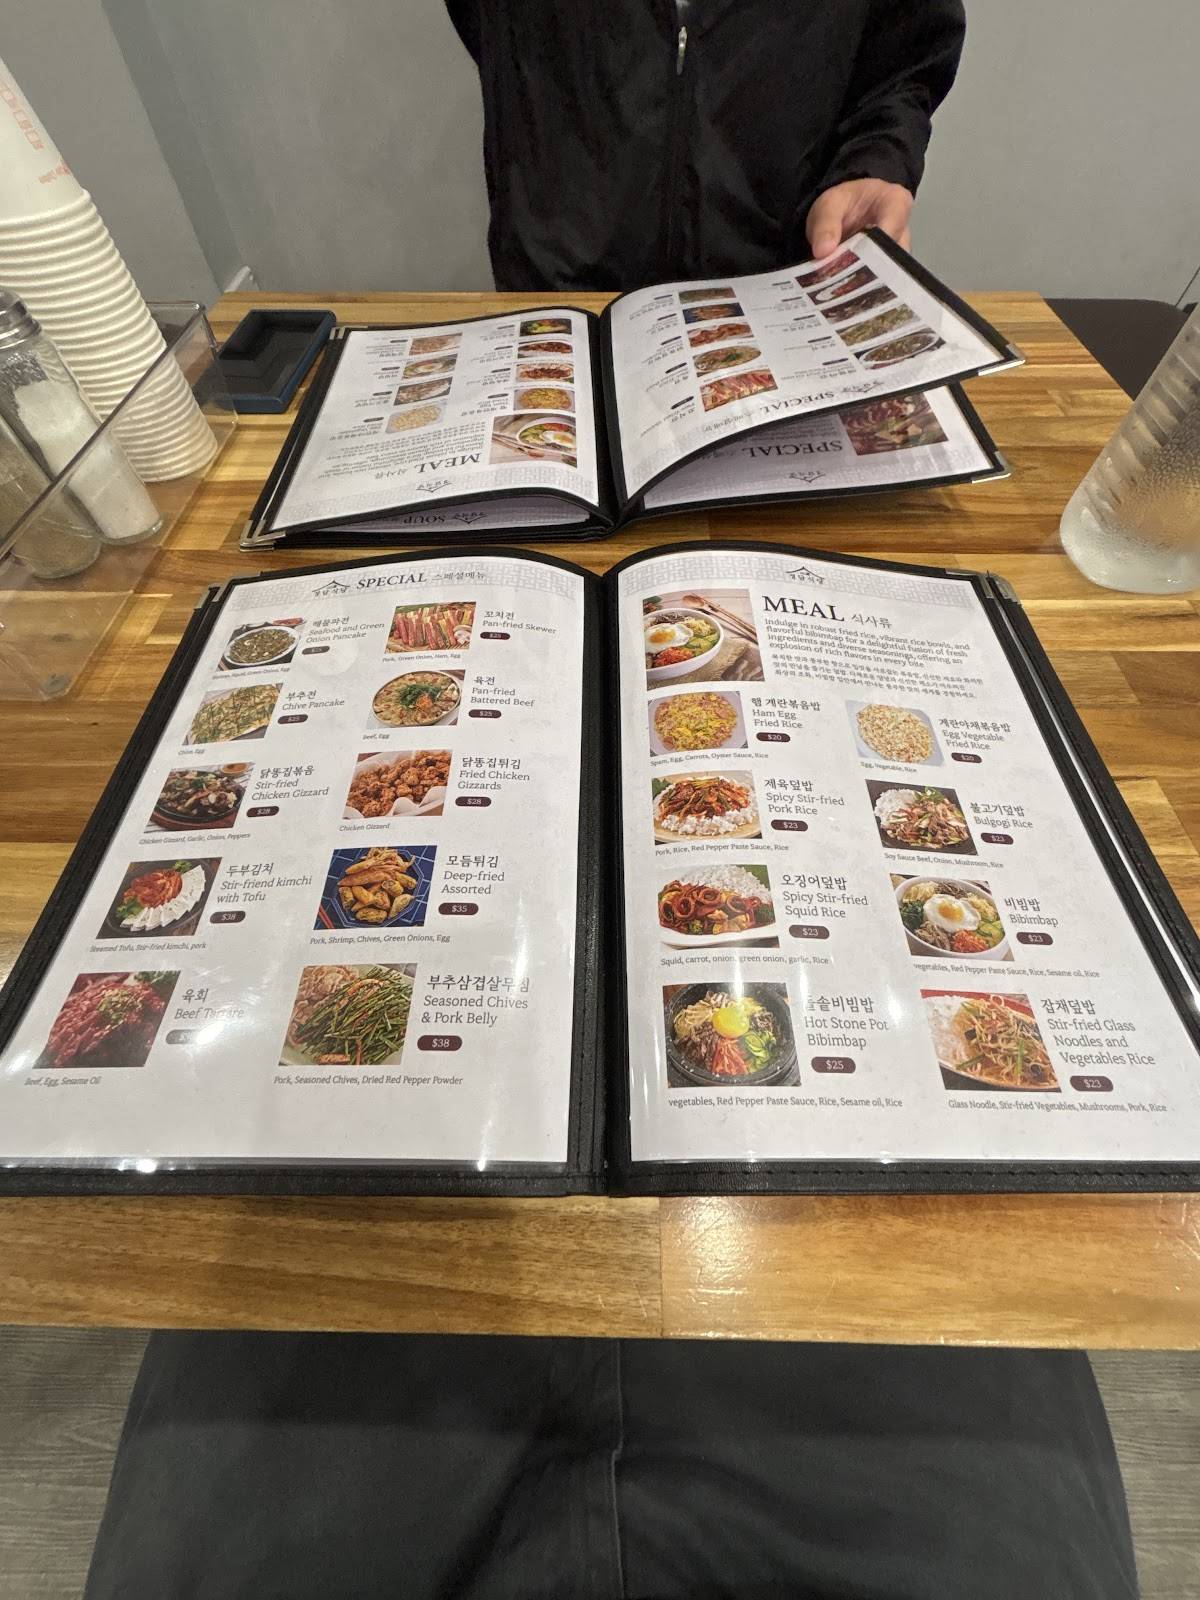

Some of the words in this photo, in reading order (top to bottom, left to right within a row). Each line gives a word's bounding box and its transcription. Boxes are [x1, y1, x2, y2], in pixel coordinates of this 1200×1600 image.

[761, 390, 834, 414] SPECIAL
[748, 439, 843, 458] SPECIAL
[414, 453, 480, 474] MEAL
[404, 515, 447, 525] SOUP
[357, 572, 427, 590] SPECIAL
[762, 596, 845, 621] MEAL
[852, 613, 892, 629] 식사류
[309, 626, 342, 636] Seafood
[343, 624, 358, 632] and
[360, 622, 385, 630] Green
[483, 620, 523, 629] Pan-fried
[526, 623, 557, 634] Skewer
[765, 619, 798, 628] Indulge
[811, 625, 836, 633] robust
[839, 628, 858, 636] fried
[880, 635, 907, 643] vibrant
[306, 635, 330, 643] Onion
[332, 632, 366, 641] Pancake
[767, 626, 803, 634] flavorful
[805, 630, 843, 641] bibimbap
[867, 640, 906, 650] delightful
[908, 645, 933, 654] fusion
[946, 649, 968, 657] fresh
[768, 634, 817, 644] ingredients
[838, 641, 867, 651] diverse
[917, 654, 951, 664] offering
[770, 642, 812, 651] explosion
[826, 648, 842, 656] rich
[844, 649, 872, 660] flavors
[884, 658, 906, 666] every
[472, 687, 515, 696] Pan-fried
[283, 702, 307, 710] Chive
[308, 699, 345, 709] Pancake
[471, 697, 511, 705] Battered
[514, 699, 535, 707] Beef
[753, 709, 776, 717] Ham
[778, 711, 796, 720] Egg
[754, 719, 780, 728] Fried
[783, 720, 802, 728] Rice
[943, 730, 960, 740] Egg
[962, 731, 1005, 742] Vegetable
[946, 740, 969, 748] Fried
[971, 742, 990, 750] Rice
[462, 757, 521, 769] 닭똥집튀김
[489, 771, 530, 780] Chicken
[255, 779, 299, 789] Stir-fried
[458, 782, 502, 790] Gizzards
[764, 779, 813, 791] 제육덮밥
[252, 791, 290, 800] Chicken
[293, 787, 329, 797] Gizzard
[766, 793, 795, 804] Spicy
[798, 794, 845, 805] Stir-fried
[768, 804, 793, 814] Pork
[796, 806, 817, 815] Rice
[970, 802, 1025, 817] 불고기덮밥
[783, 821, 798, 829] $23
[974, 816, 1011, 828] Bulgogi
[1012, 819, 1034, 828] Rice
[447, 856, 498, 868] 모듬튀김
[226, 863, 274, 876] 두부김치
[221, 878, 273, 890] Stir-friend
[276, 876, 312, 886] kimchi
[443, 871, 504, 883] Deep-fried
[782, 874, 847, 890] 오징어덮밥
[442, 884, 491, 894] Assorted
[217, 893, 239, 903] with
[242, 892, 266, 901] Tofu
[783, 892, 814, 904] Spicy
[817, 893, 868, 905] Stir-fried
[1005, 897, 1041, 912] 비빔밥
[785, 905, 818, 918] Squid
[821, 906, 845, 918] Rice
[1009, 914, 1058, 927] Bibimbap
[802, 928, 818, 936] $23
[437, 934, 450, 943] Egg
[1029, 934, 1043, 943] $23
[182, 989, 208, 1003] 육회
[424, 995, 483, 1007] Seasoned
[487, 996, 528, 1009] Chives
[1041, 999, 1096, 1015] 잡채덮밥
[174, 1008, 200, 1019] Beef
[422, 1013, 430, 1023] &
[435, 1012, 465, 1024] Pork
[468, 1012, 497, 1027] Belly
[805, 1016, 827, 1030] Hot
[830, 1017, 866, 1030] Stone
[869, 1019, 888, 1031] Pot
[1048, 1018, 1102, 1031] Stir-fried
[1105, 1019, 1135, 1032] Glass
[432, 1038, 450, 1048] $38
[808, 1033, 867, 1049] Bibimbap
[1055, 1036, 1103, 1048] Noodles
[1106, 1036, 1128, 1048] and
[826, 1060, 844, 1070] $25
[1060, 1052, 1126, 1067] Vegetables
[1129, 1052, 1155, 1065] Rice
[274, 1076, 292, 1085] Pork,
[295, 1076, 330, 1085] Seasoned
[333, 1076, 360, 1085] Chives,
[362, 1075, 384, 1084] Dried
[386, 1075, 401, 1084] Red
[403, 1075, 430, 1086] Pepper
[433, 1076, 463, 1085] Powder
[1084, 1078, 1101, 1089] $23
[669, 1097, 715, 1108] vegetables,
[717, 1096, 733, 1106] Red
[735, 1096, 763, 1108] Pepper
[766, 1097, 788, 1106] Paste
[790, 1097, 817, 1107] Sauce,
[819, 1097, 838, 1107] Rice,
[840, 1098, 869, 1107] Sesame
[872, 1098, 884, 1107] oil,
[886, 1098, 902, 1107] Rice
